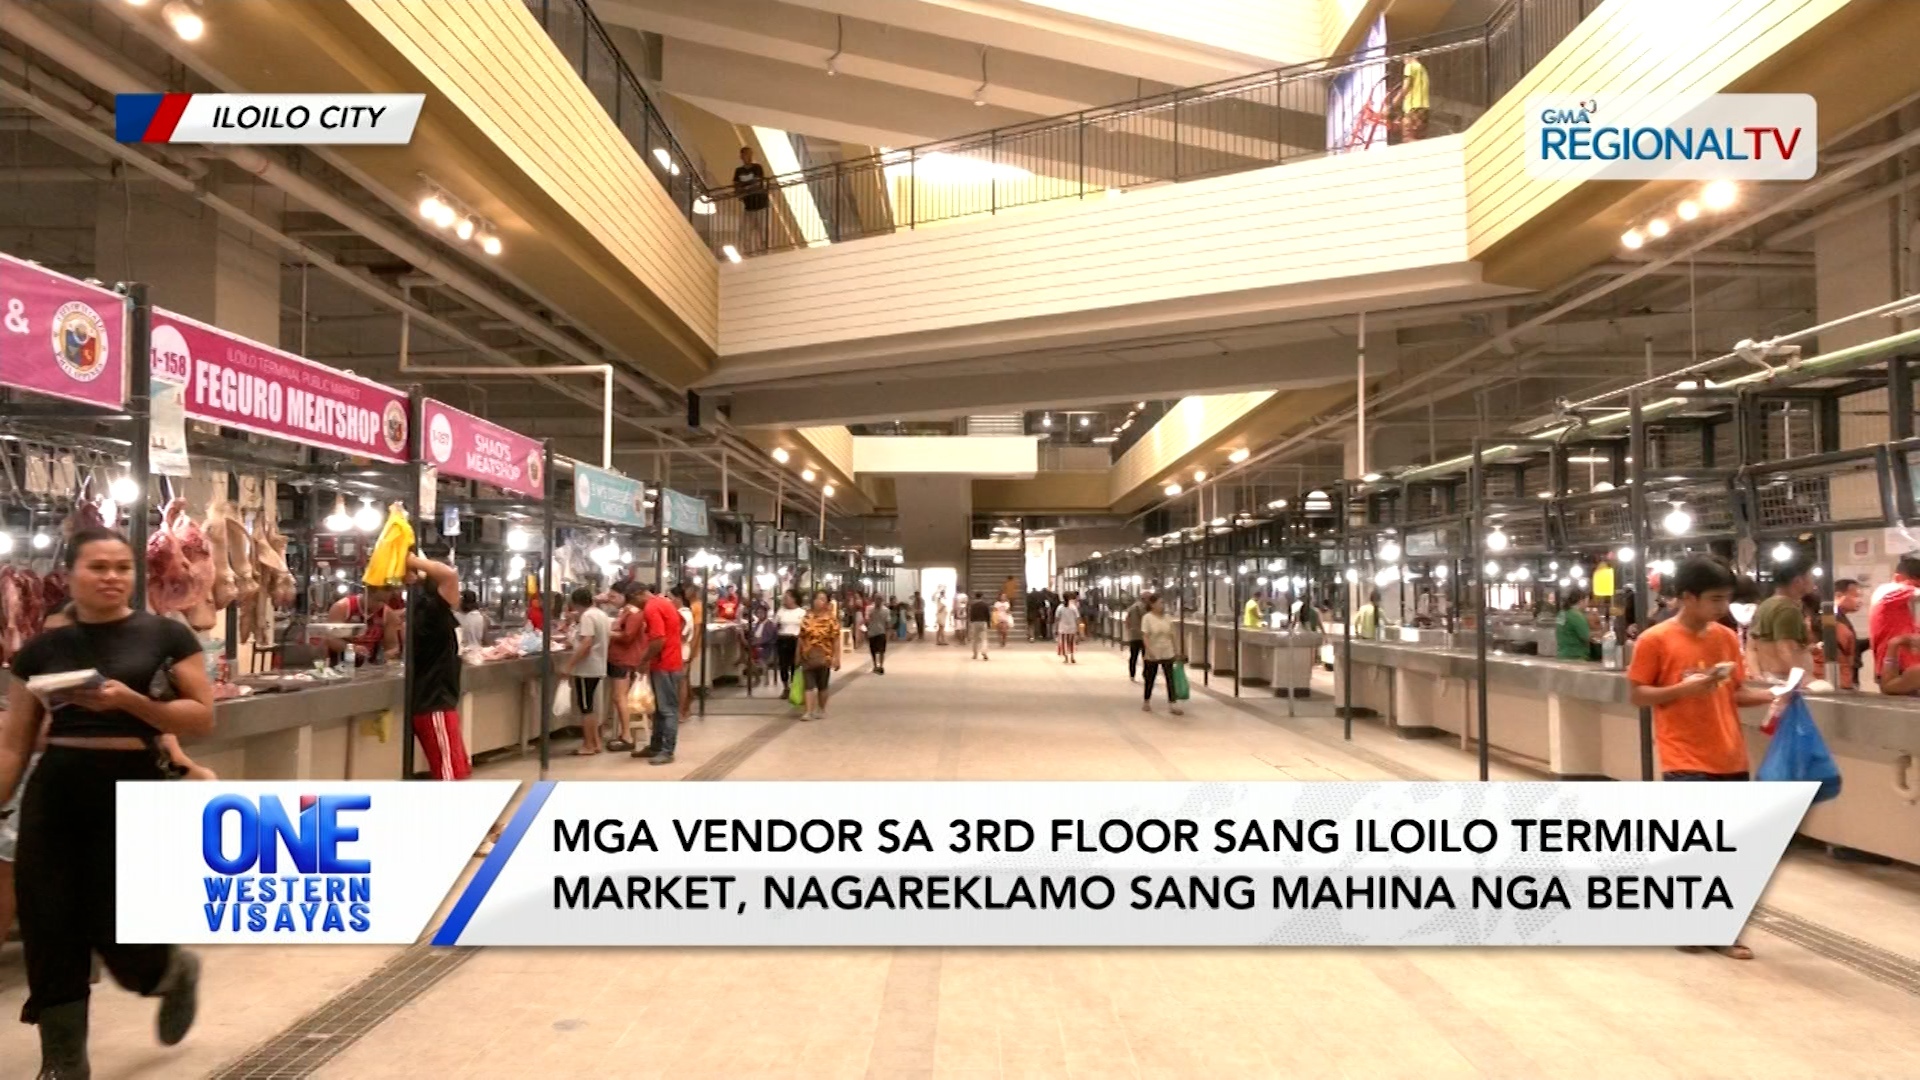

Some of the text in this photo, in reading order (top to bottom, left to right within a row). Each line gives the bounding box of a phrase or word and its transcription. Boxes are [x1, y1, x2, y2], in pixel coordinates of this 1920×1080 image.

[4, 297, 31, 334] &
[150, 347, 187, 377] 1-158
[195, 359, 381, 446] FEGURO MEATSHOP
[465, 451, 521, 480] MEATSHOP
